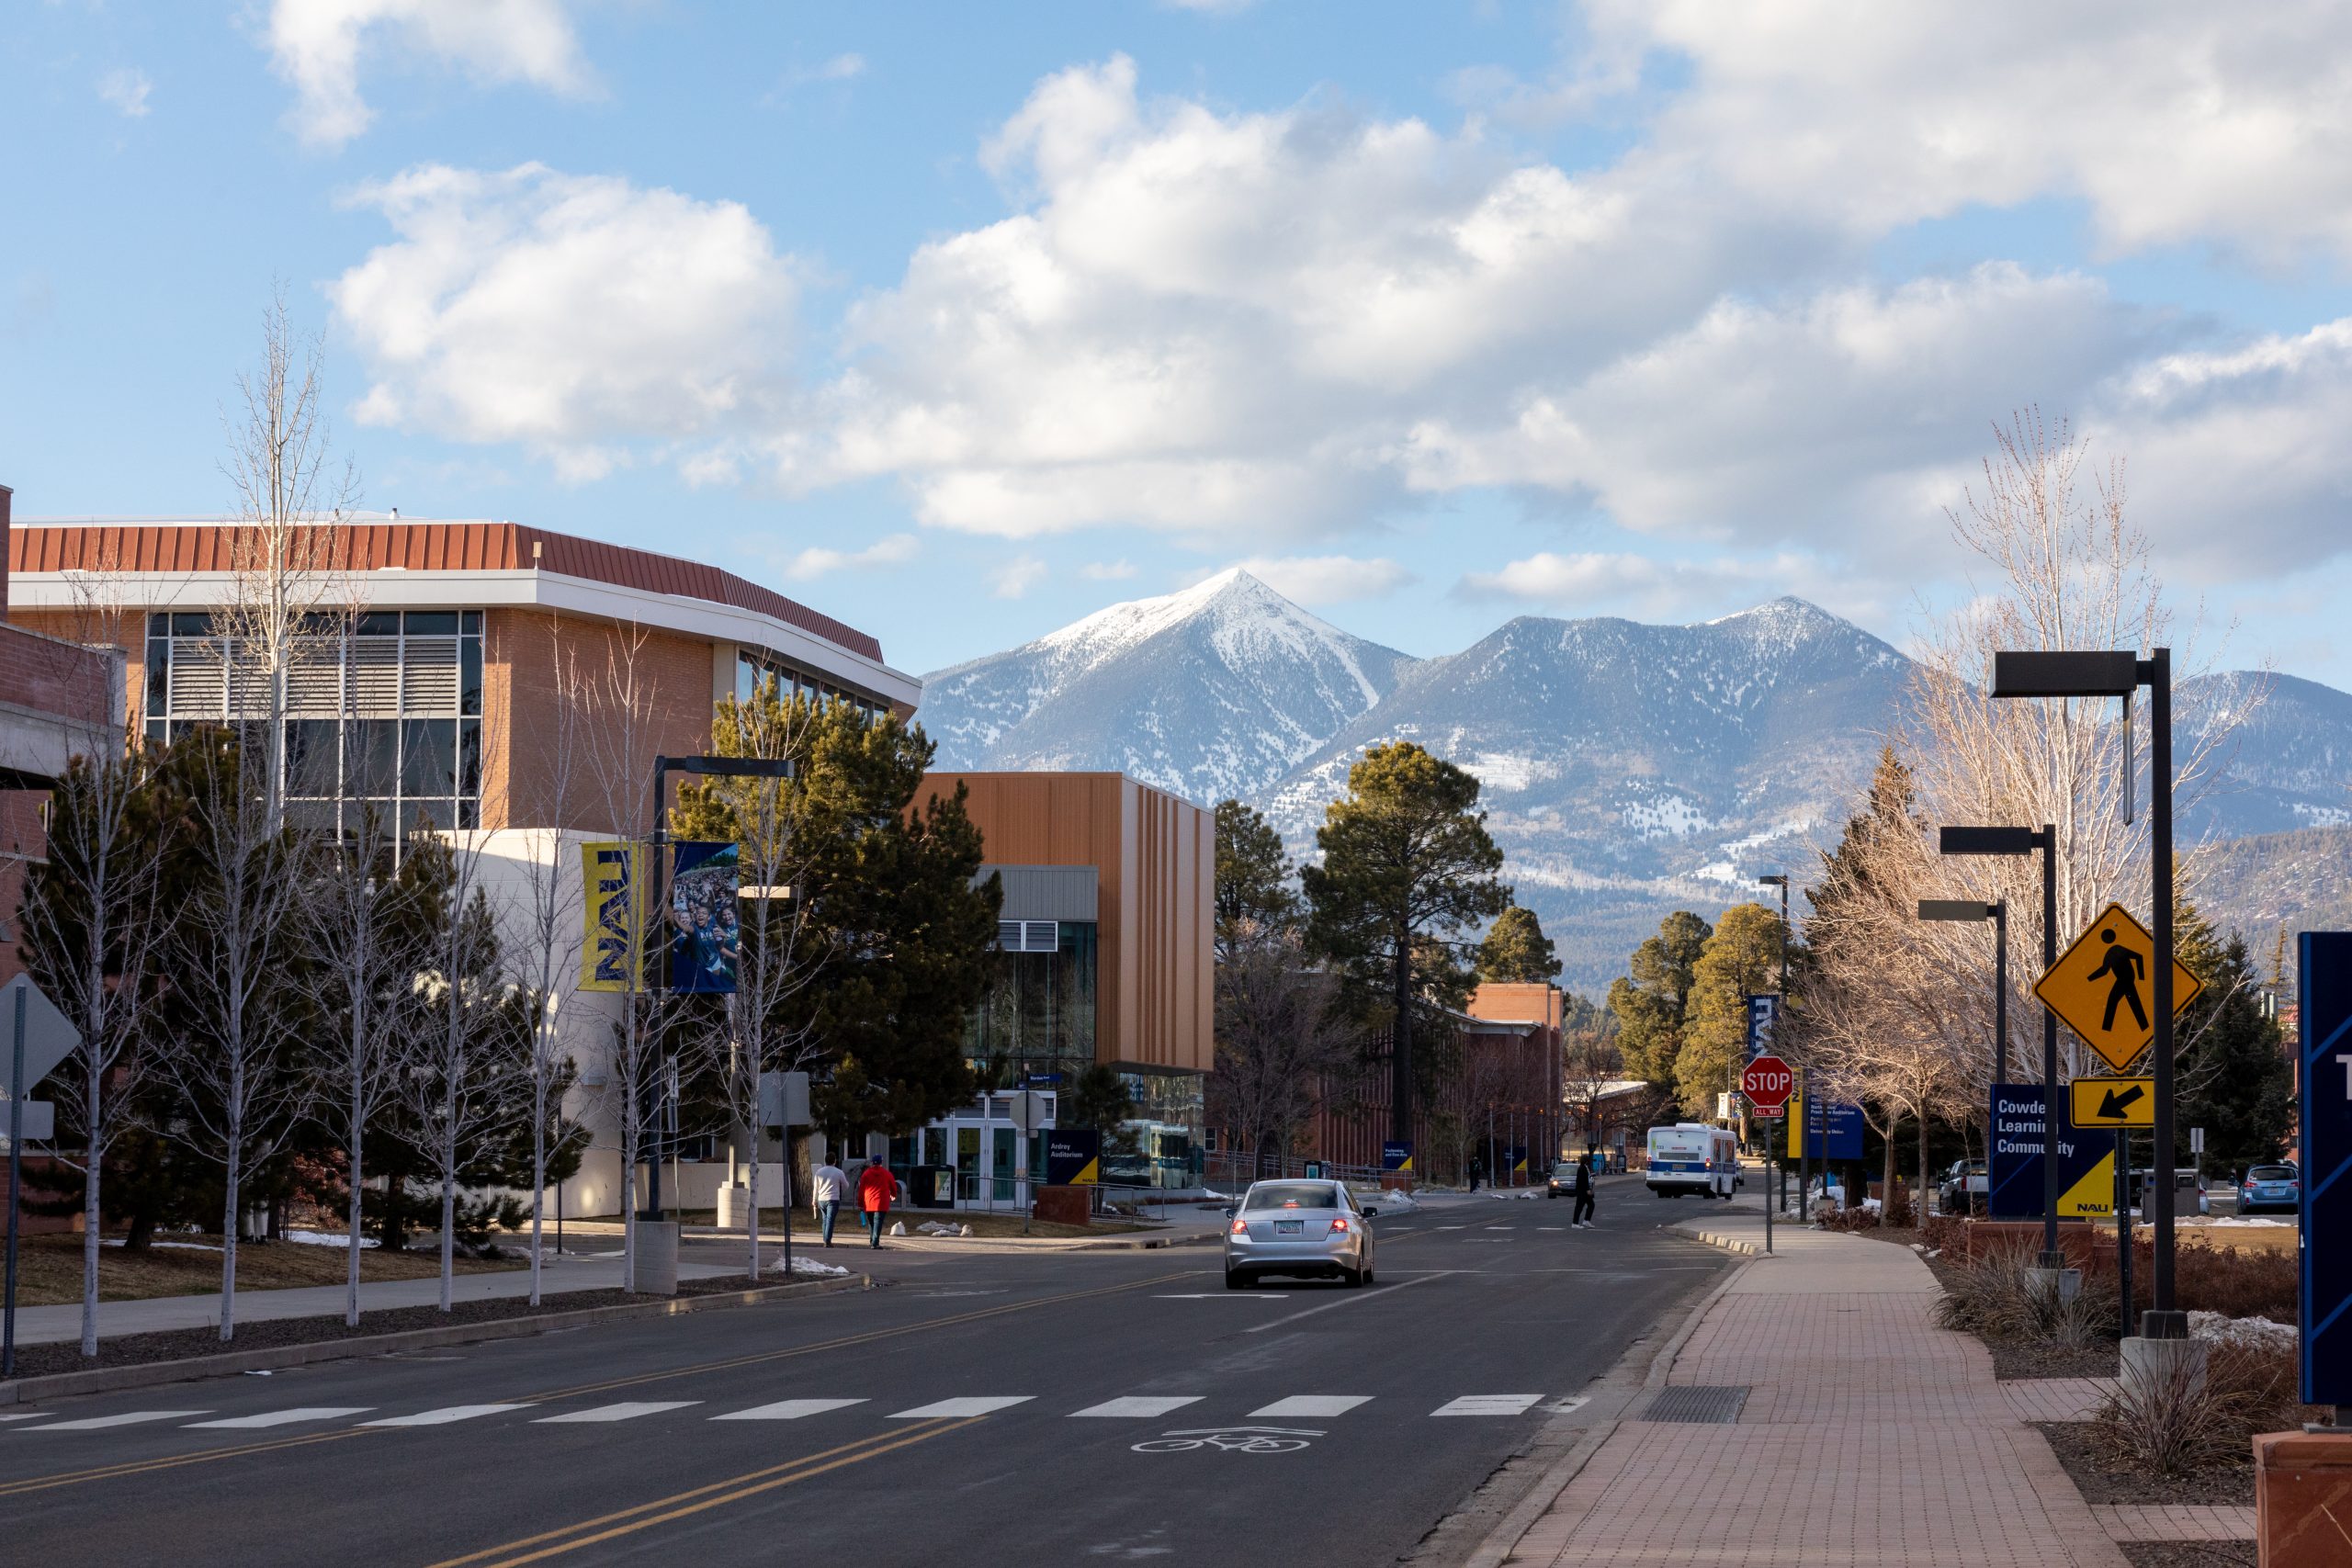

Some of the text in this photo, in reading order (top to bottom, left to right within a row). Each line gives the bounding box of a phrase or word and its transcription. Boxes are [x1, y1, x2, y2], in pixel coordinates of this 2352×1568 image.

[595, 851, 629, 982] NAU
[1747, 1073, 1790, 1091] STOP
[1998, 1100, 2045, 1114] Cowde
[1998, 1119, 2059, 1134] Learni
[1997, 1139, 2075, 1157] Commuity
[2077, 1203, 2109, 1213] NAU
